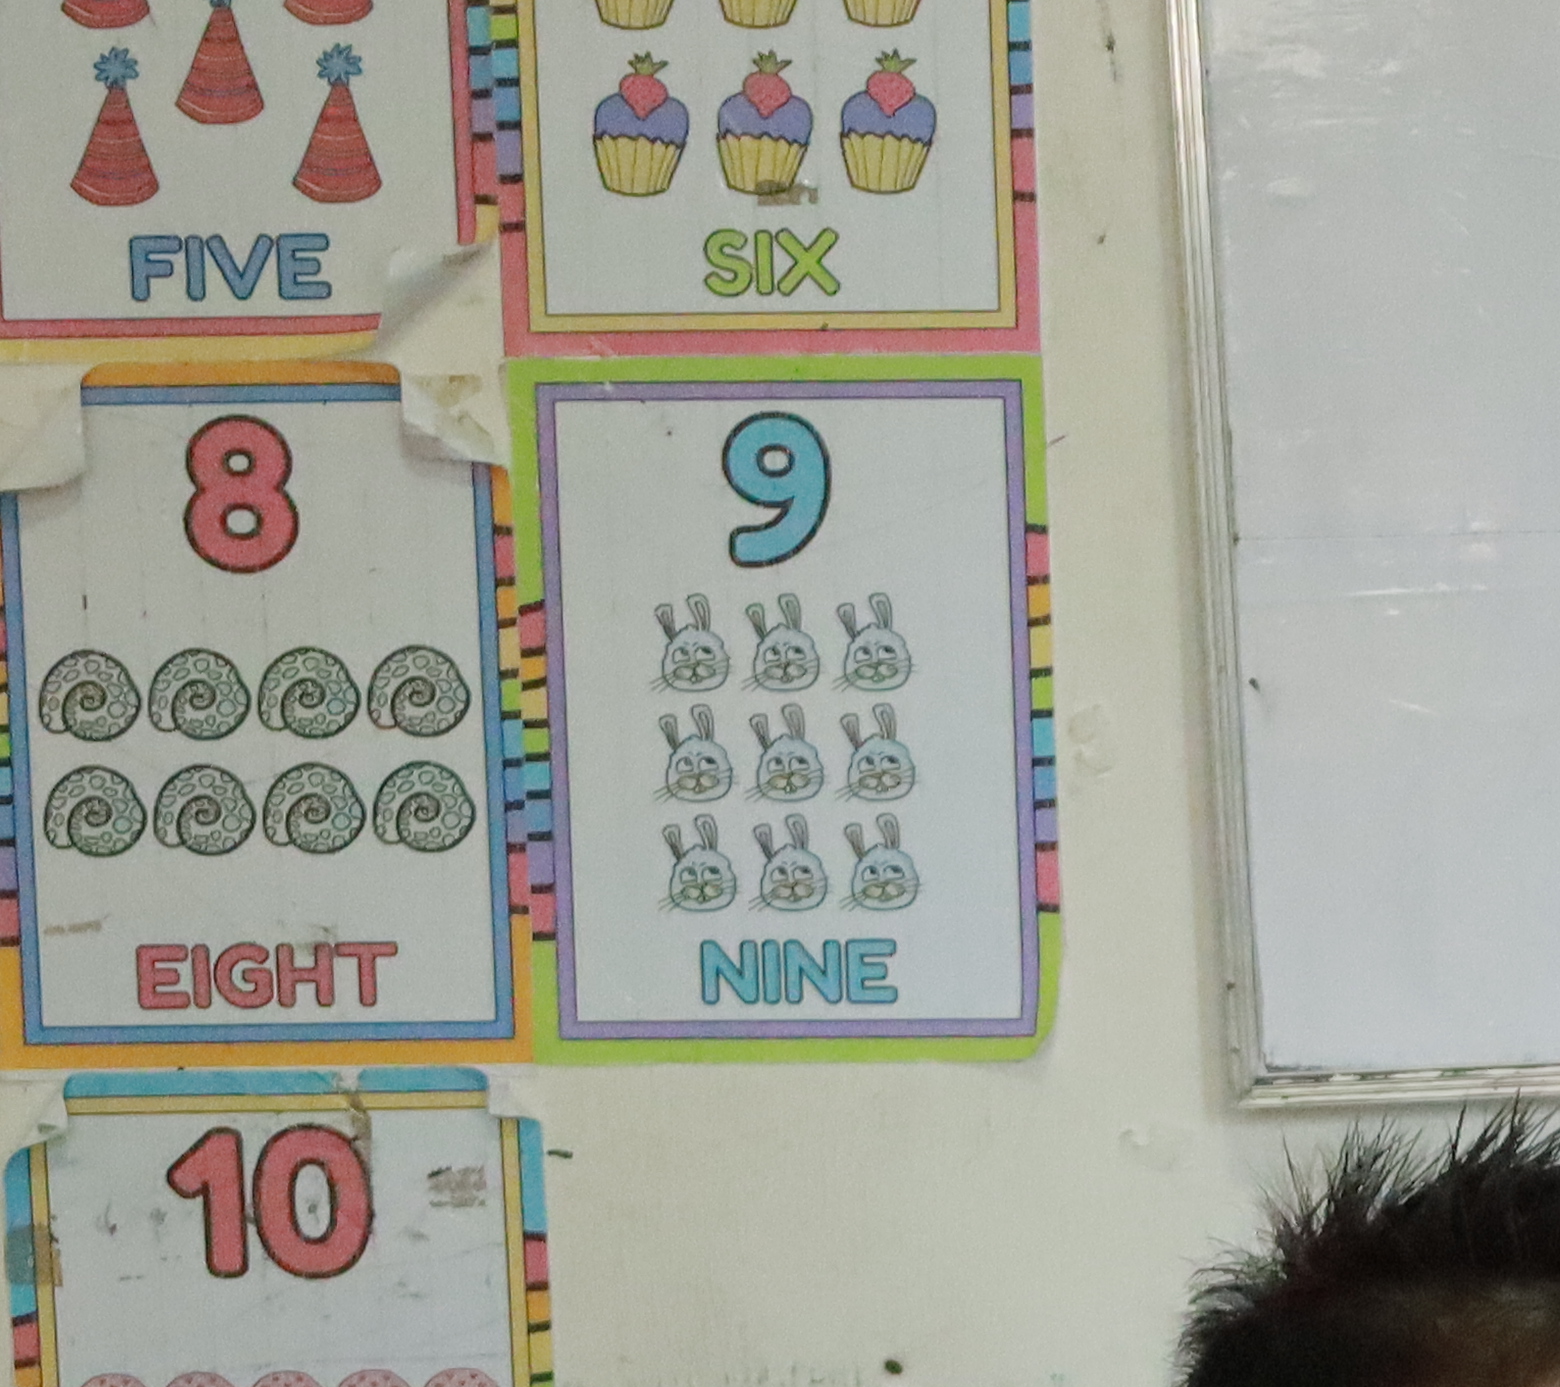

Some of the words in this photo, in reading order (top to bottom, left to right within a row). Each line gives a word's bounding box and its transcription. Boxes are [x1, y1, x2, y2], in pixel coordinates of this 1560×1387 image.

[129, 232, 332, 301] FIVE
[702, 228, 840, 298] SIX
[183, 414, 299, 574] 8
[721, 411, 832, 569] 9
[136, 940, 398, 1010] EIGHT
[699, 937, 898, 1006] NINE
[166, 1122, 374, 1279] 10
